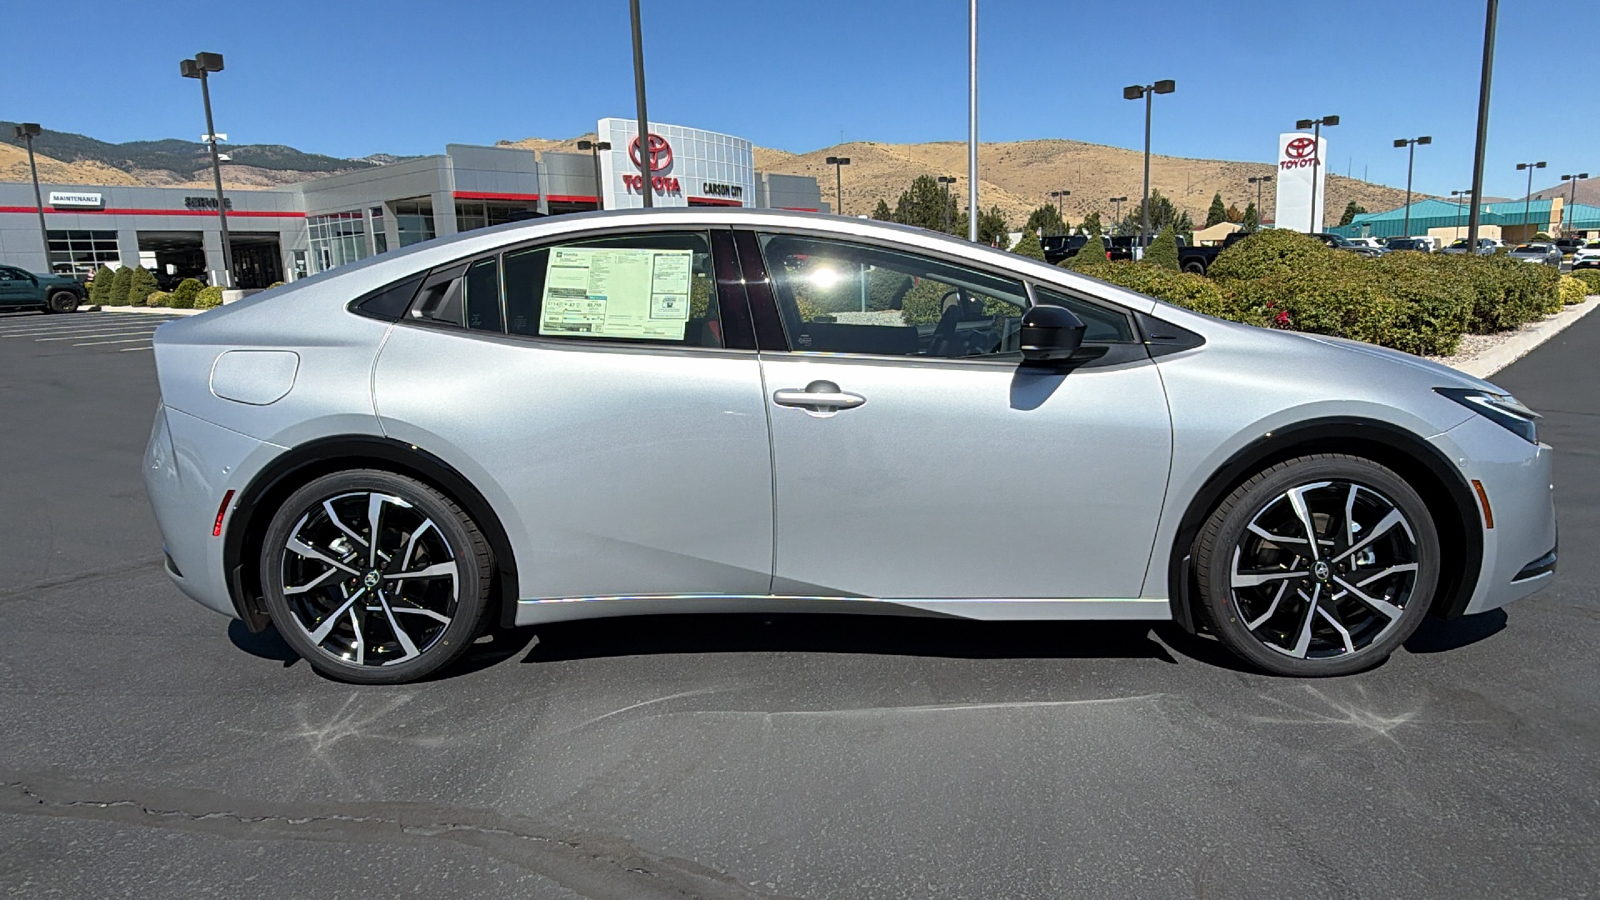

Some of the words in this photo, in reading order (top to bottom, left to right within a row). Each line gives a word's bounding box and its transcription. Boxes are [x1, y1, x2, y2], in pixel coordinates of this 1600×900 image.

[622, 175, 681, 192] TOOTA
[703, 182, 730, 196] CARSON
[731, 185, 743, 198] CITY
[185, 197, 232, 208] SERVIE
